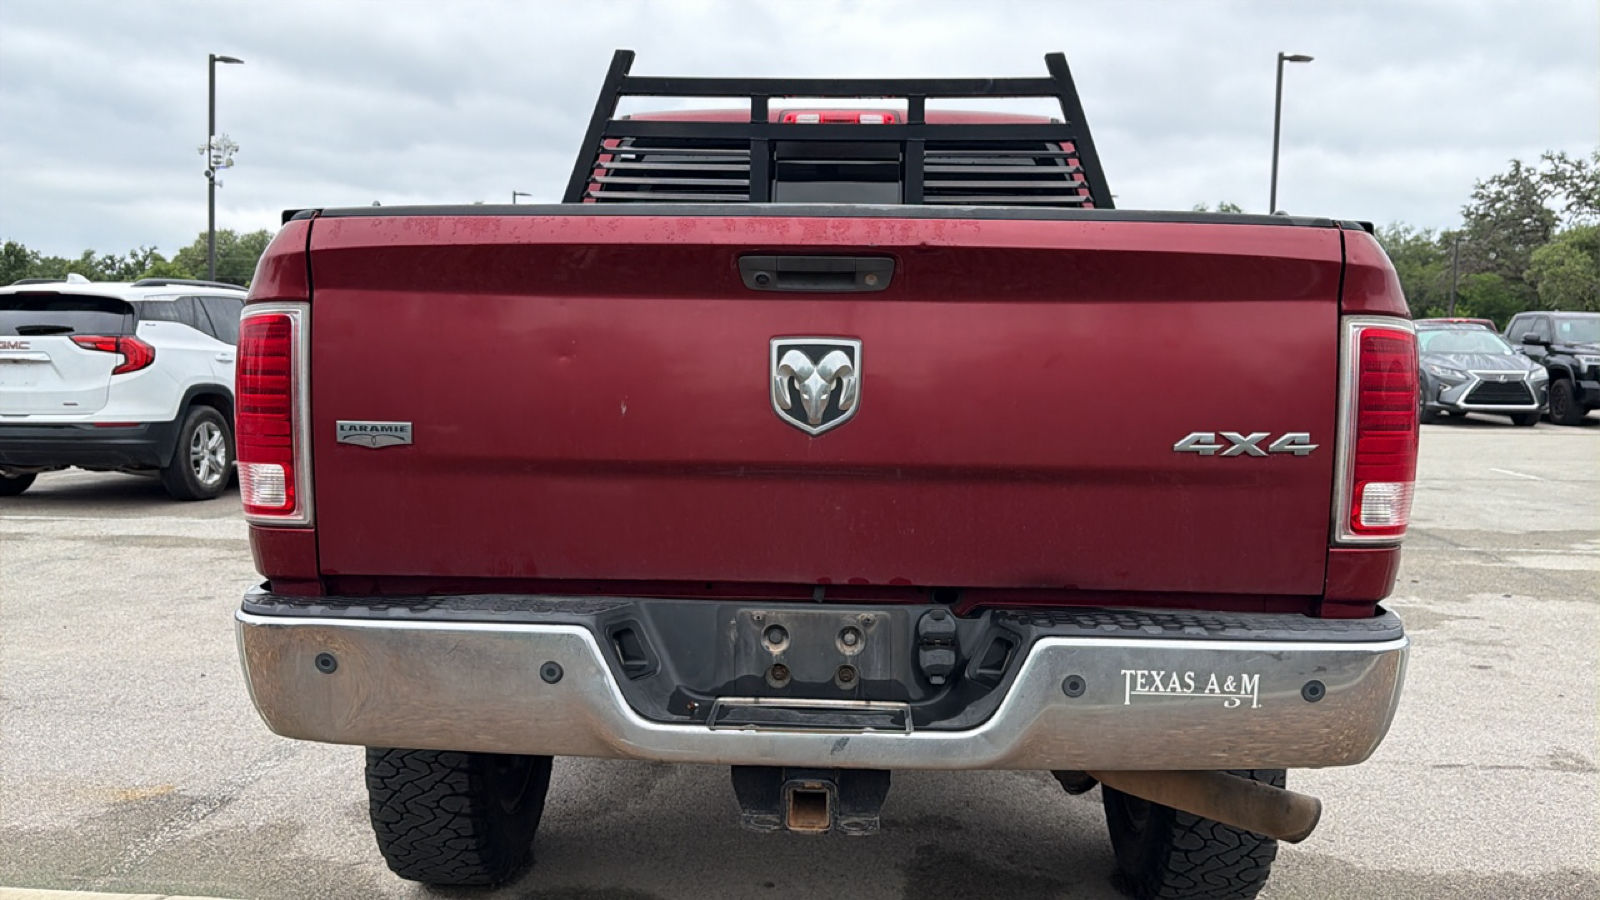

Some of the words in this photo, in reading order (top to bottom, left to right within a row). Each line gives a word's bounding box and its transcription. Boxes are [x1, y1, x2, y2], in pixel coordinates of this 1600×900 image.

[340, 424, 409, 432] LARAMIE
[1173, 432, 1320, 456] 4X4
[1121, 669, 1195, 705] TEXAS
